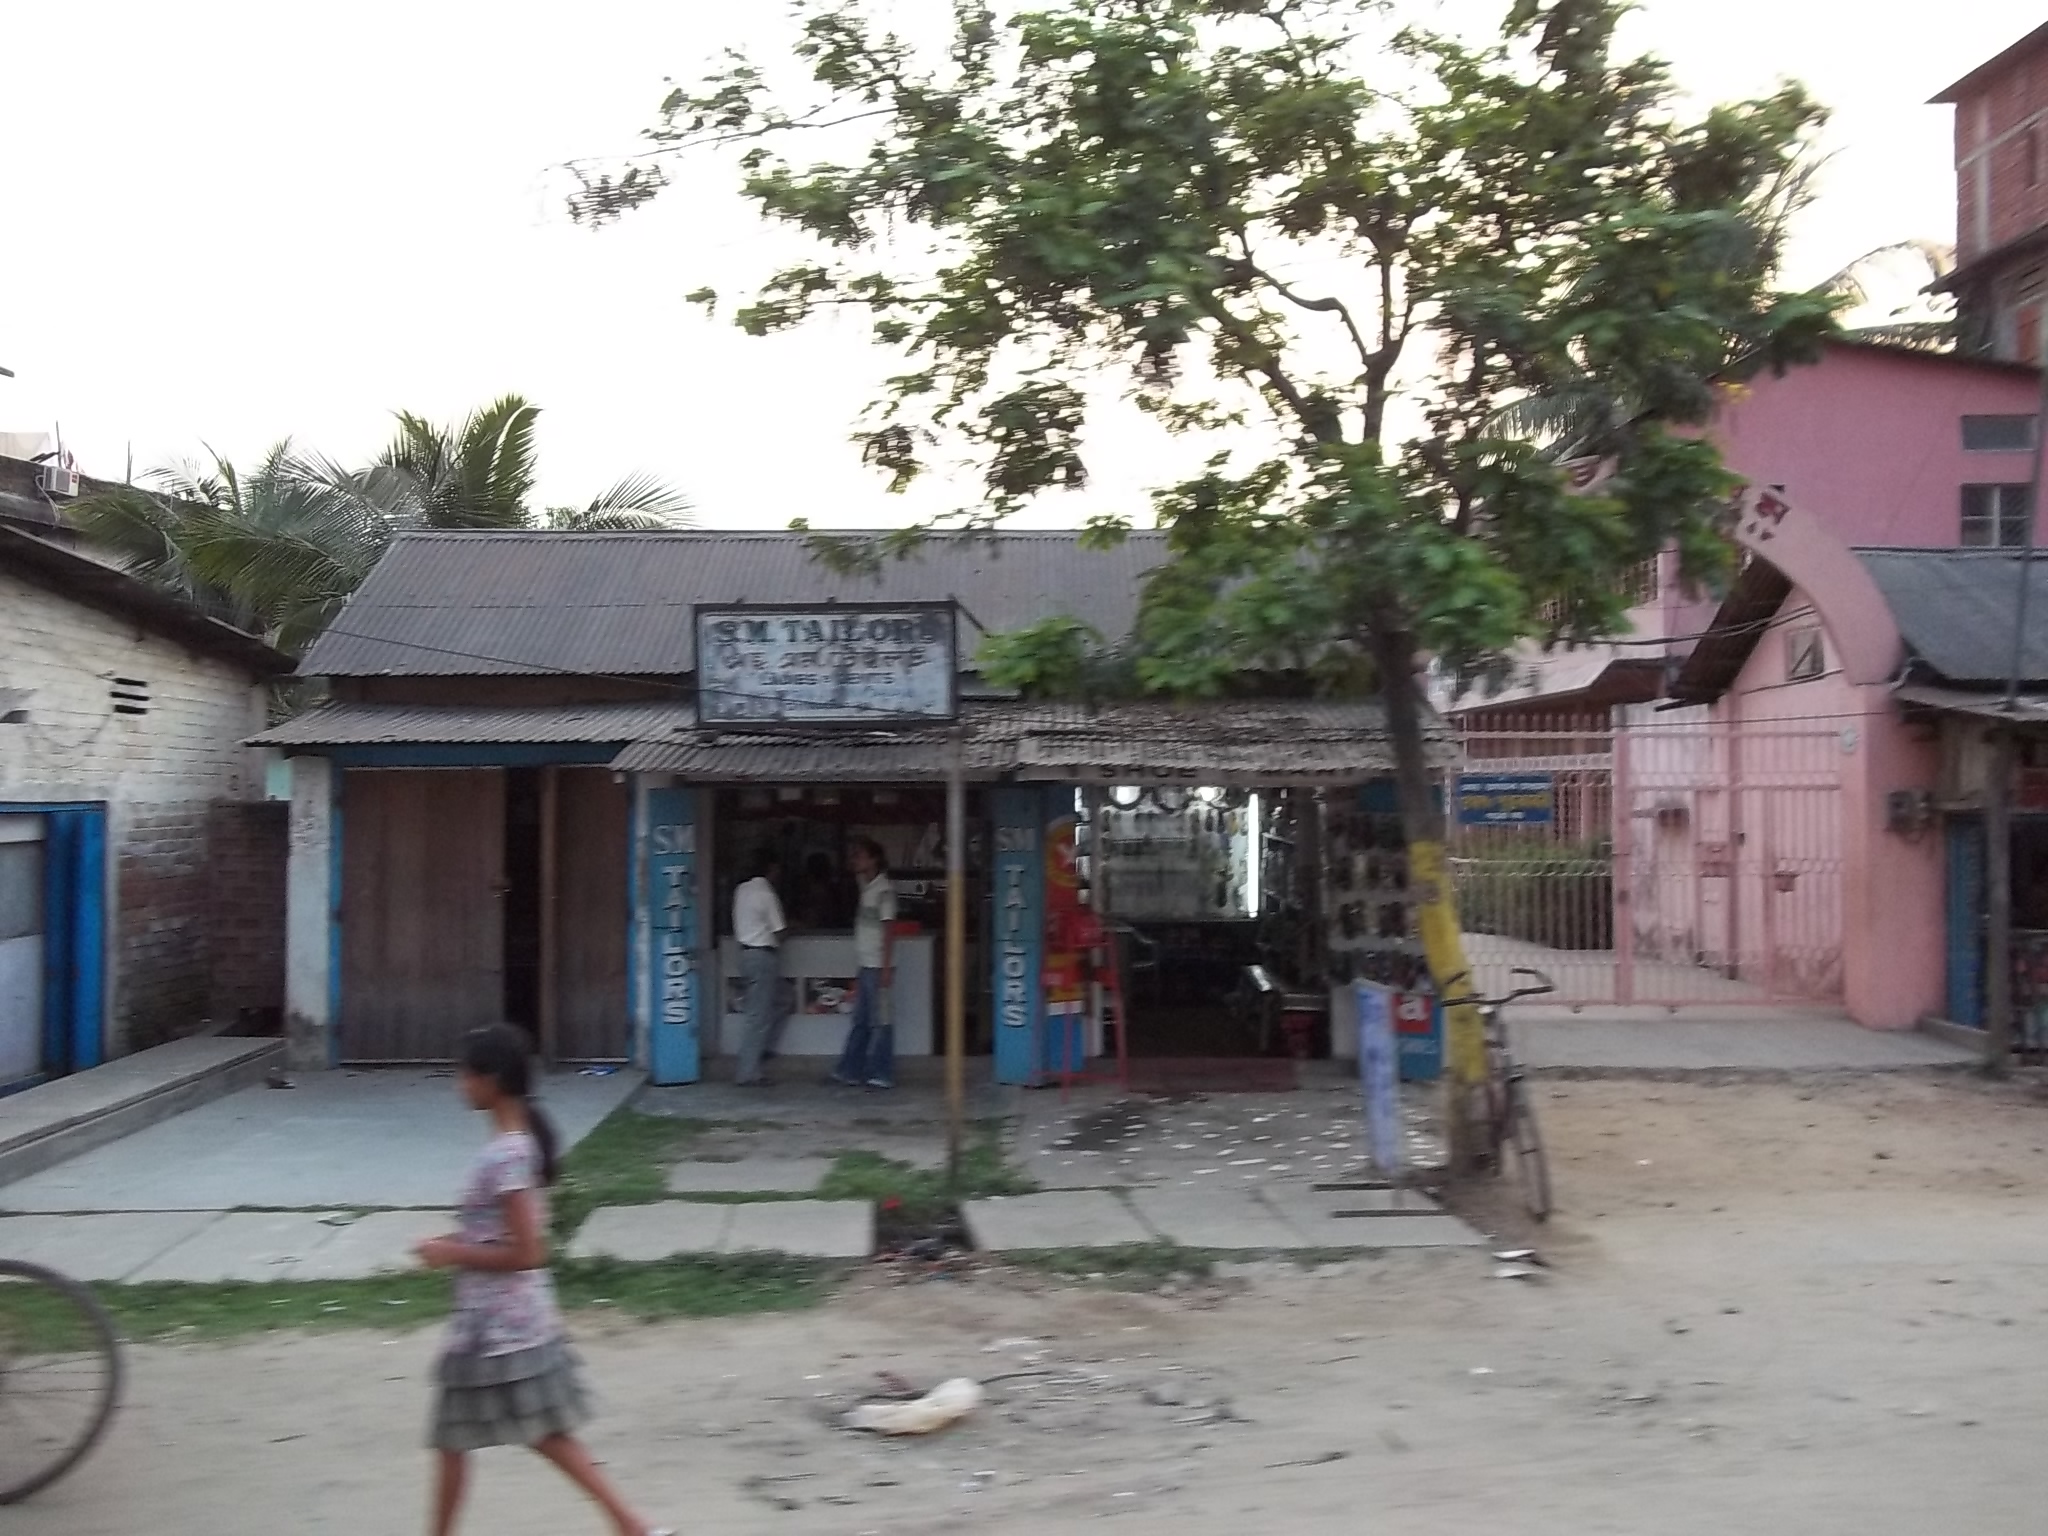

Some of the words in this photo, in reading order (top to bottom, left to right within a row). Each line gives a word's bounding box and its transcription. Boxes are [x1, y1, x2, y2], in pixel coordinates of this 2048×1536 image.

[653, 824, 696, 855] SM
[997, 827, 1036, 853] SM
[660, 863, 692, 1026] TAILORS
[1003, 863, 1028, 1028] TAILORS
